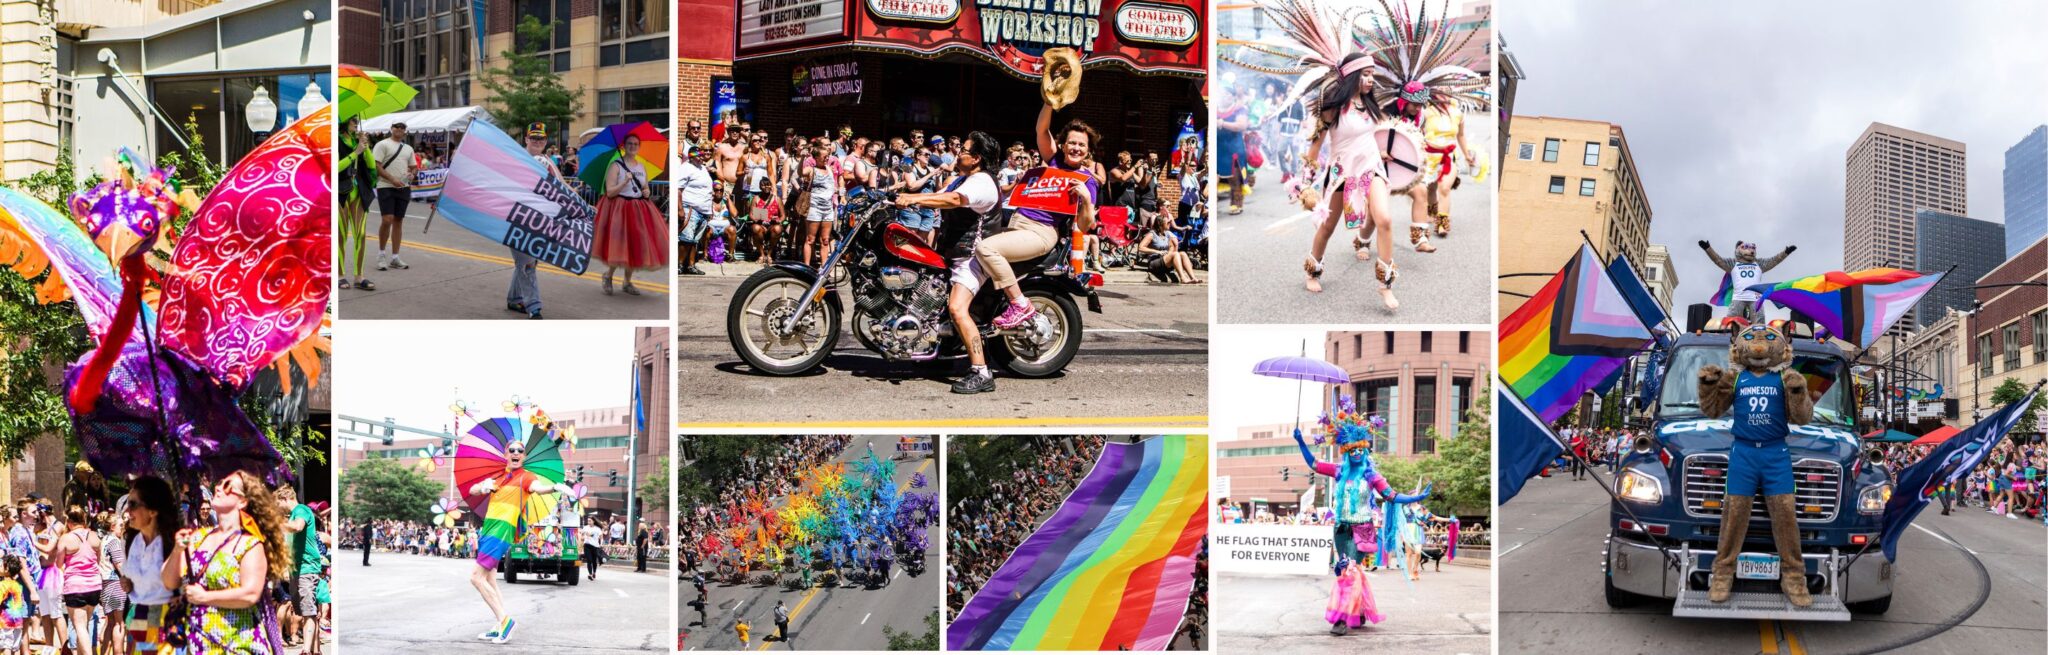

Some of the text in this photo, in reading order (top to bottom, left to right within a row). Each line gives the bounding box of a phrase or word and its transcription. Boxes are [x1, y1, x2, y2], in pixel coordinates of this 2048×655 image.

[774, 8, 803, 24] ELECTION
[803, 3, 822, 18] SHOW
[878, 0, 949, 15] THEATRE
[1128, 9, 1184, 23] COMEDY
[765, 22, 806, 40] 612-332-6620
[981, 8, 1100, 51] WORKSHOP
[1125, 22, 1187, 37] THEATRE
[827, 65, 833, 79] IN
[816, 82, 833, 96] DRINK
[421, 133, 446, 142] Proud
[1026, 175, 1072, 191] Betsy
[510, 205, 592, 254] HUMAN
[557, 215, 593, 237] ARE
[507, 227, 586, 274] RIGHTS
[1740, 386, 1778, 396] MINNESOTA
[1748, 396, 1769, 412] 99
[921, 442, 933, 451] ON
[1232, 536, 1259, 546] FLAG
[1261, 537, 1288, 547] THAT
[1290, 538, 1333, 549] STANDS
[1231, 550, 1310, 562] FOR EVERYONE
[1740, 561, 1773, 573] YBV9863
